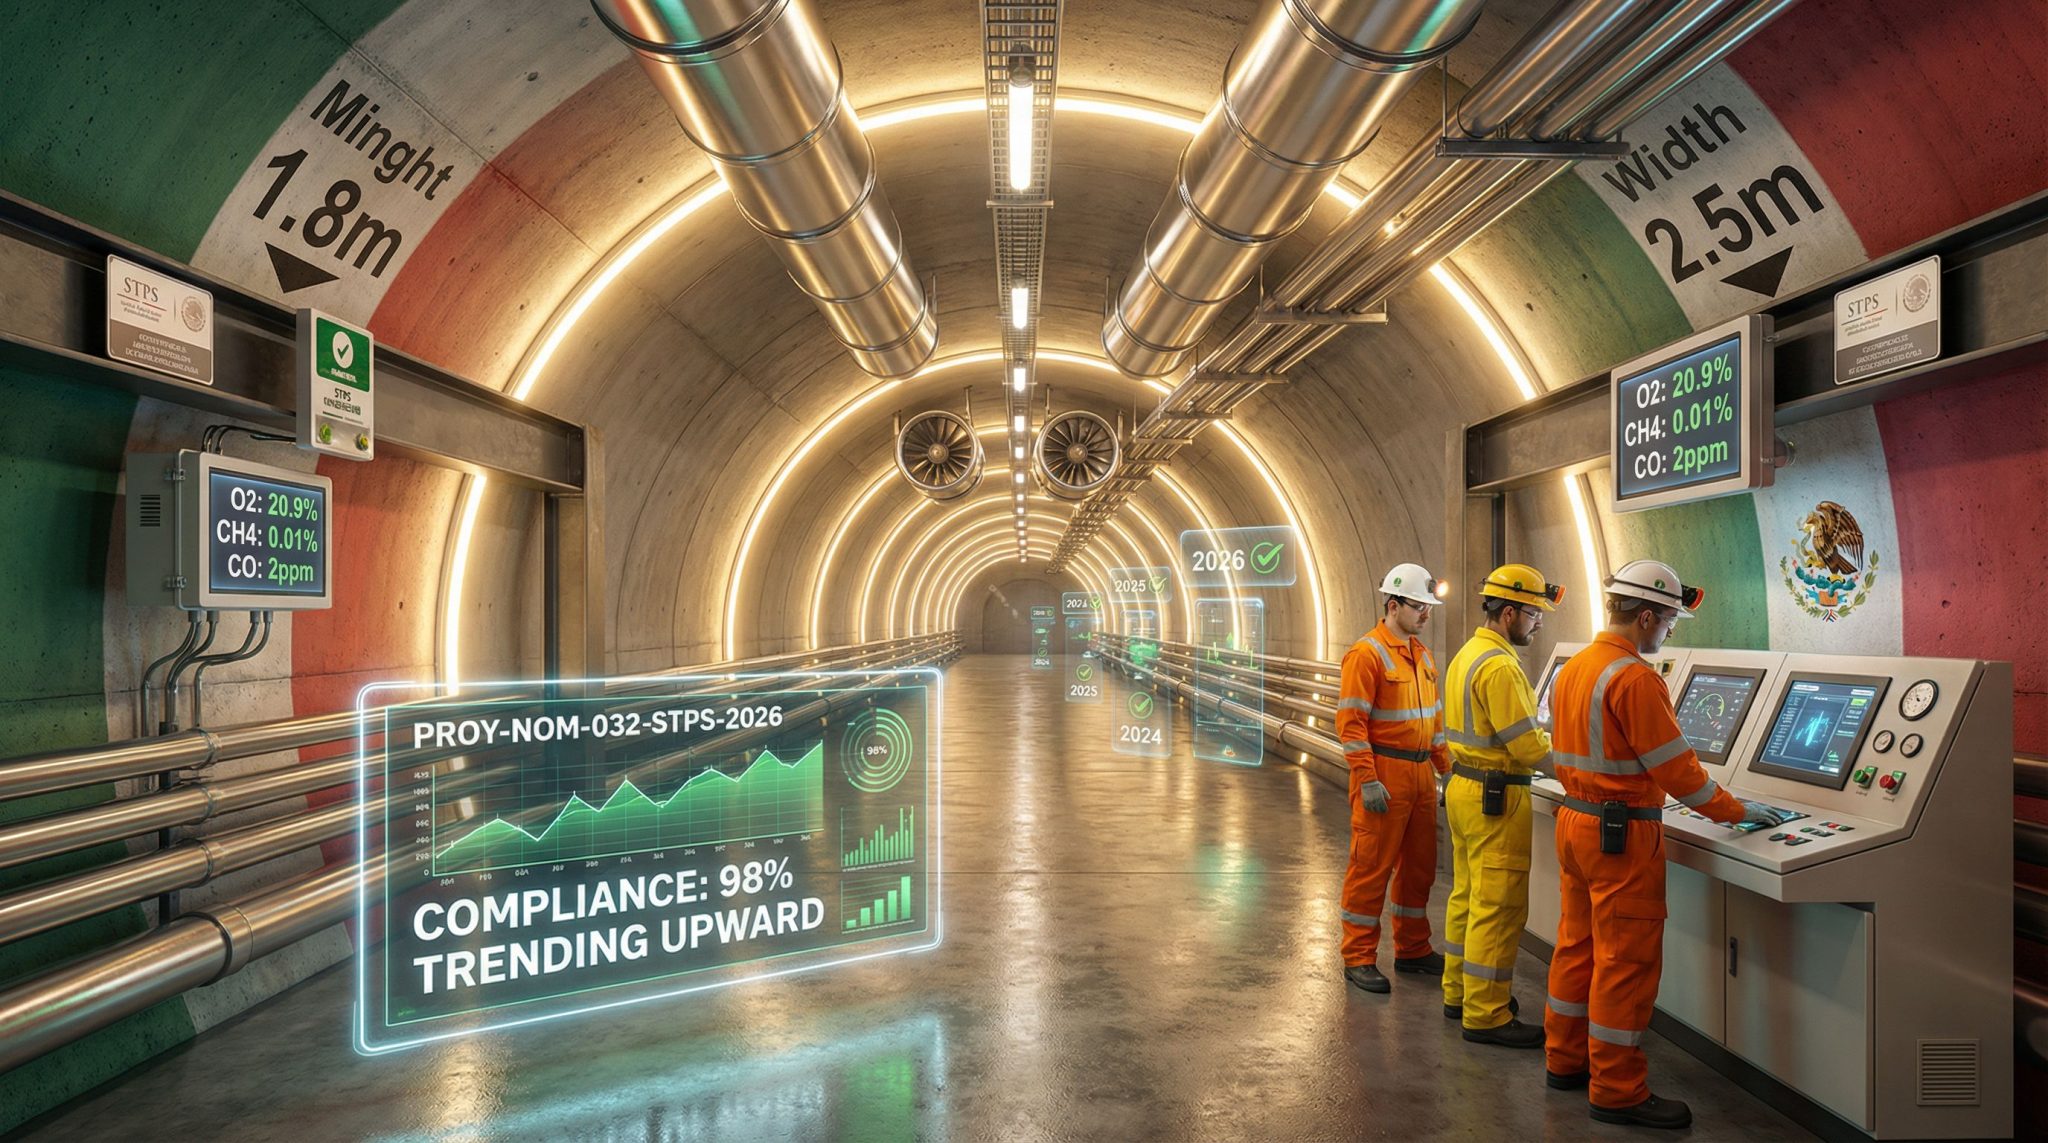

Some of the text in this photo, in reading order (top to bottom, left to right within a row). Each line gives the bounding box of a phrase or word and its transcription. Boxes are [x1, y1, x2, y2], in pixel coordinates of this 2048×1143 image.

[310, 79, 454, 201] Minght
[1602, 102, 1747, 204] Width
[252, 148, 403, 279] 1.8m
[1644, 164, 1825, 284] 2.5m
[123, 276, 159, 304] STPS
[1847, 293, 1880, 318] STPS
[1636, 353, 1733, 409] O2: 20.9%
[1624, 393, 1733, 447] CH4: 0.01%
[1634, 440, 1729, 480] CO: 2ppm
[230, 486, 318, 521] O2: 20.9%
[216, 518, 318, 553] CH4: 0.01%
[227, 553, 314, 586] CO: 2ppm
[1192, 549, 1246, 572] 2026
[1114, 579, 1147, 593] 2025
[1070, 684, 1098, 697] 2025
[413, 704, 784, 749] PROY-NOM-032-STPS-2026
[1120, 725, 1163, 745] 2024
[866, 745, 888, 756] 98%
[412, 856, 794, 941] COMPLIANCE: 98%
[413, 897, 825, 995] TRENDING UPWARD
